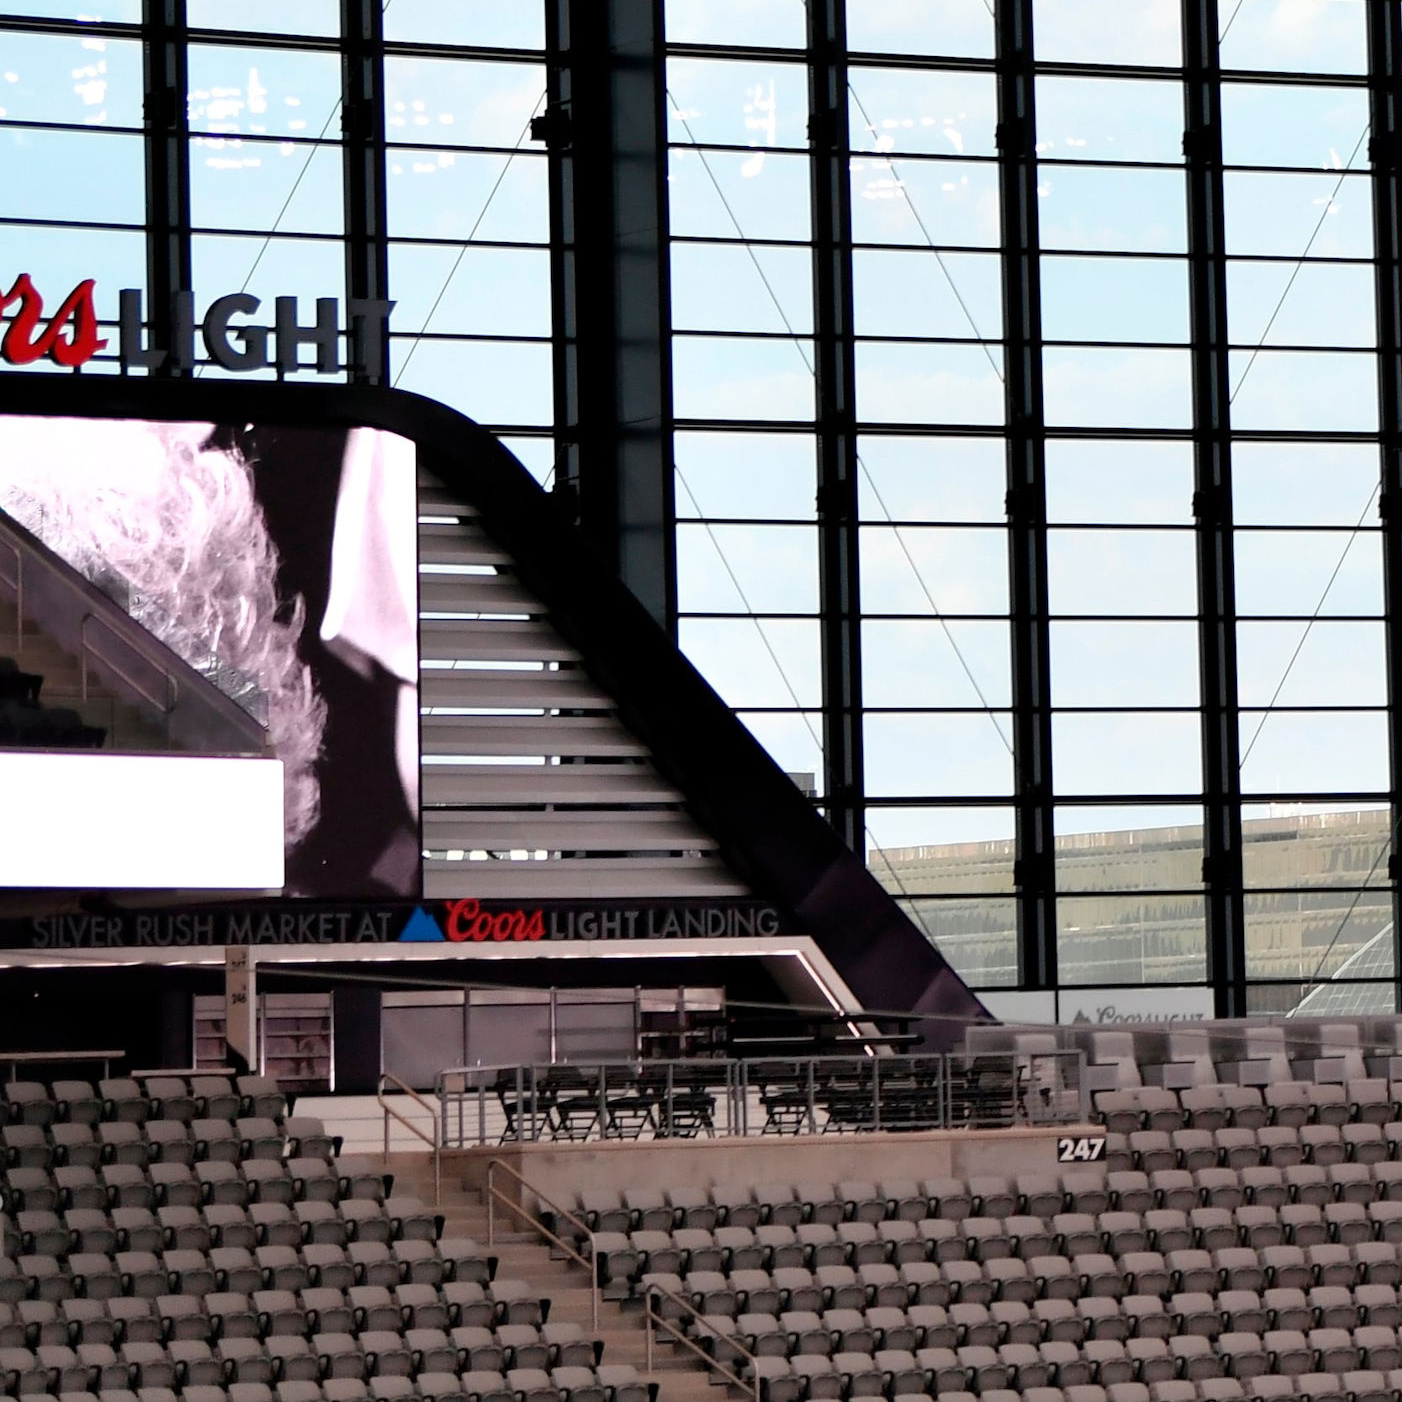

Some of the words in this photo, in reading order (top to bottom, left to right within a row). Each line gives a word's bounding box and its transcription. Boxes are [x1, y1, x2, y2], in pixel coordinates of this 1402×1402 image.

[0, 272, 109, 367] rs
[119, 288, 398, 376] LIGHT
[32, 915, 125, 948] SILVER
[136, 914, 215, 946] RUSH
[226, 912, 351, 945] MARKET
[355, 911, 393, 942] AT
[445, 898, 547, 941] Coors
[550, 910, 640, 940] LIGHT
[648, 908, 780, 939] LANDING
[1058, 1138, 1106, 1162] 247
